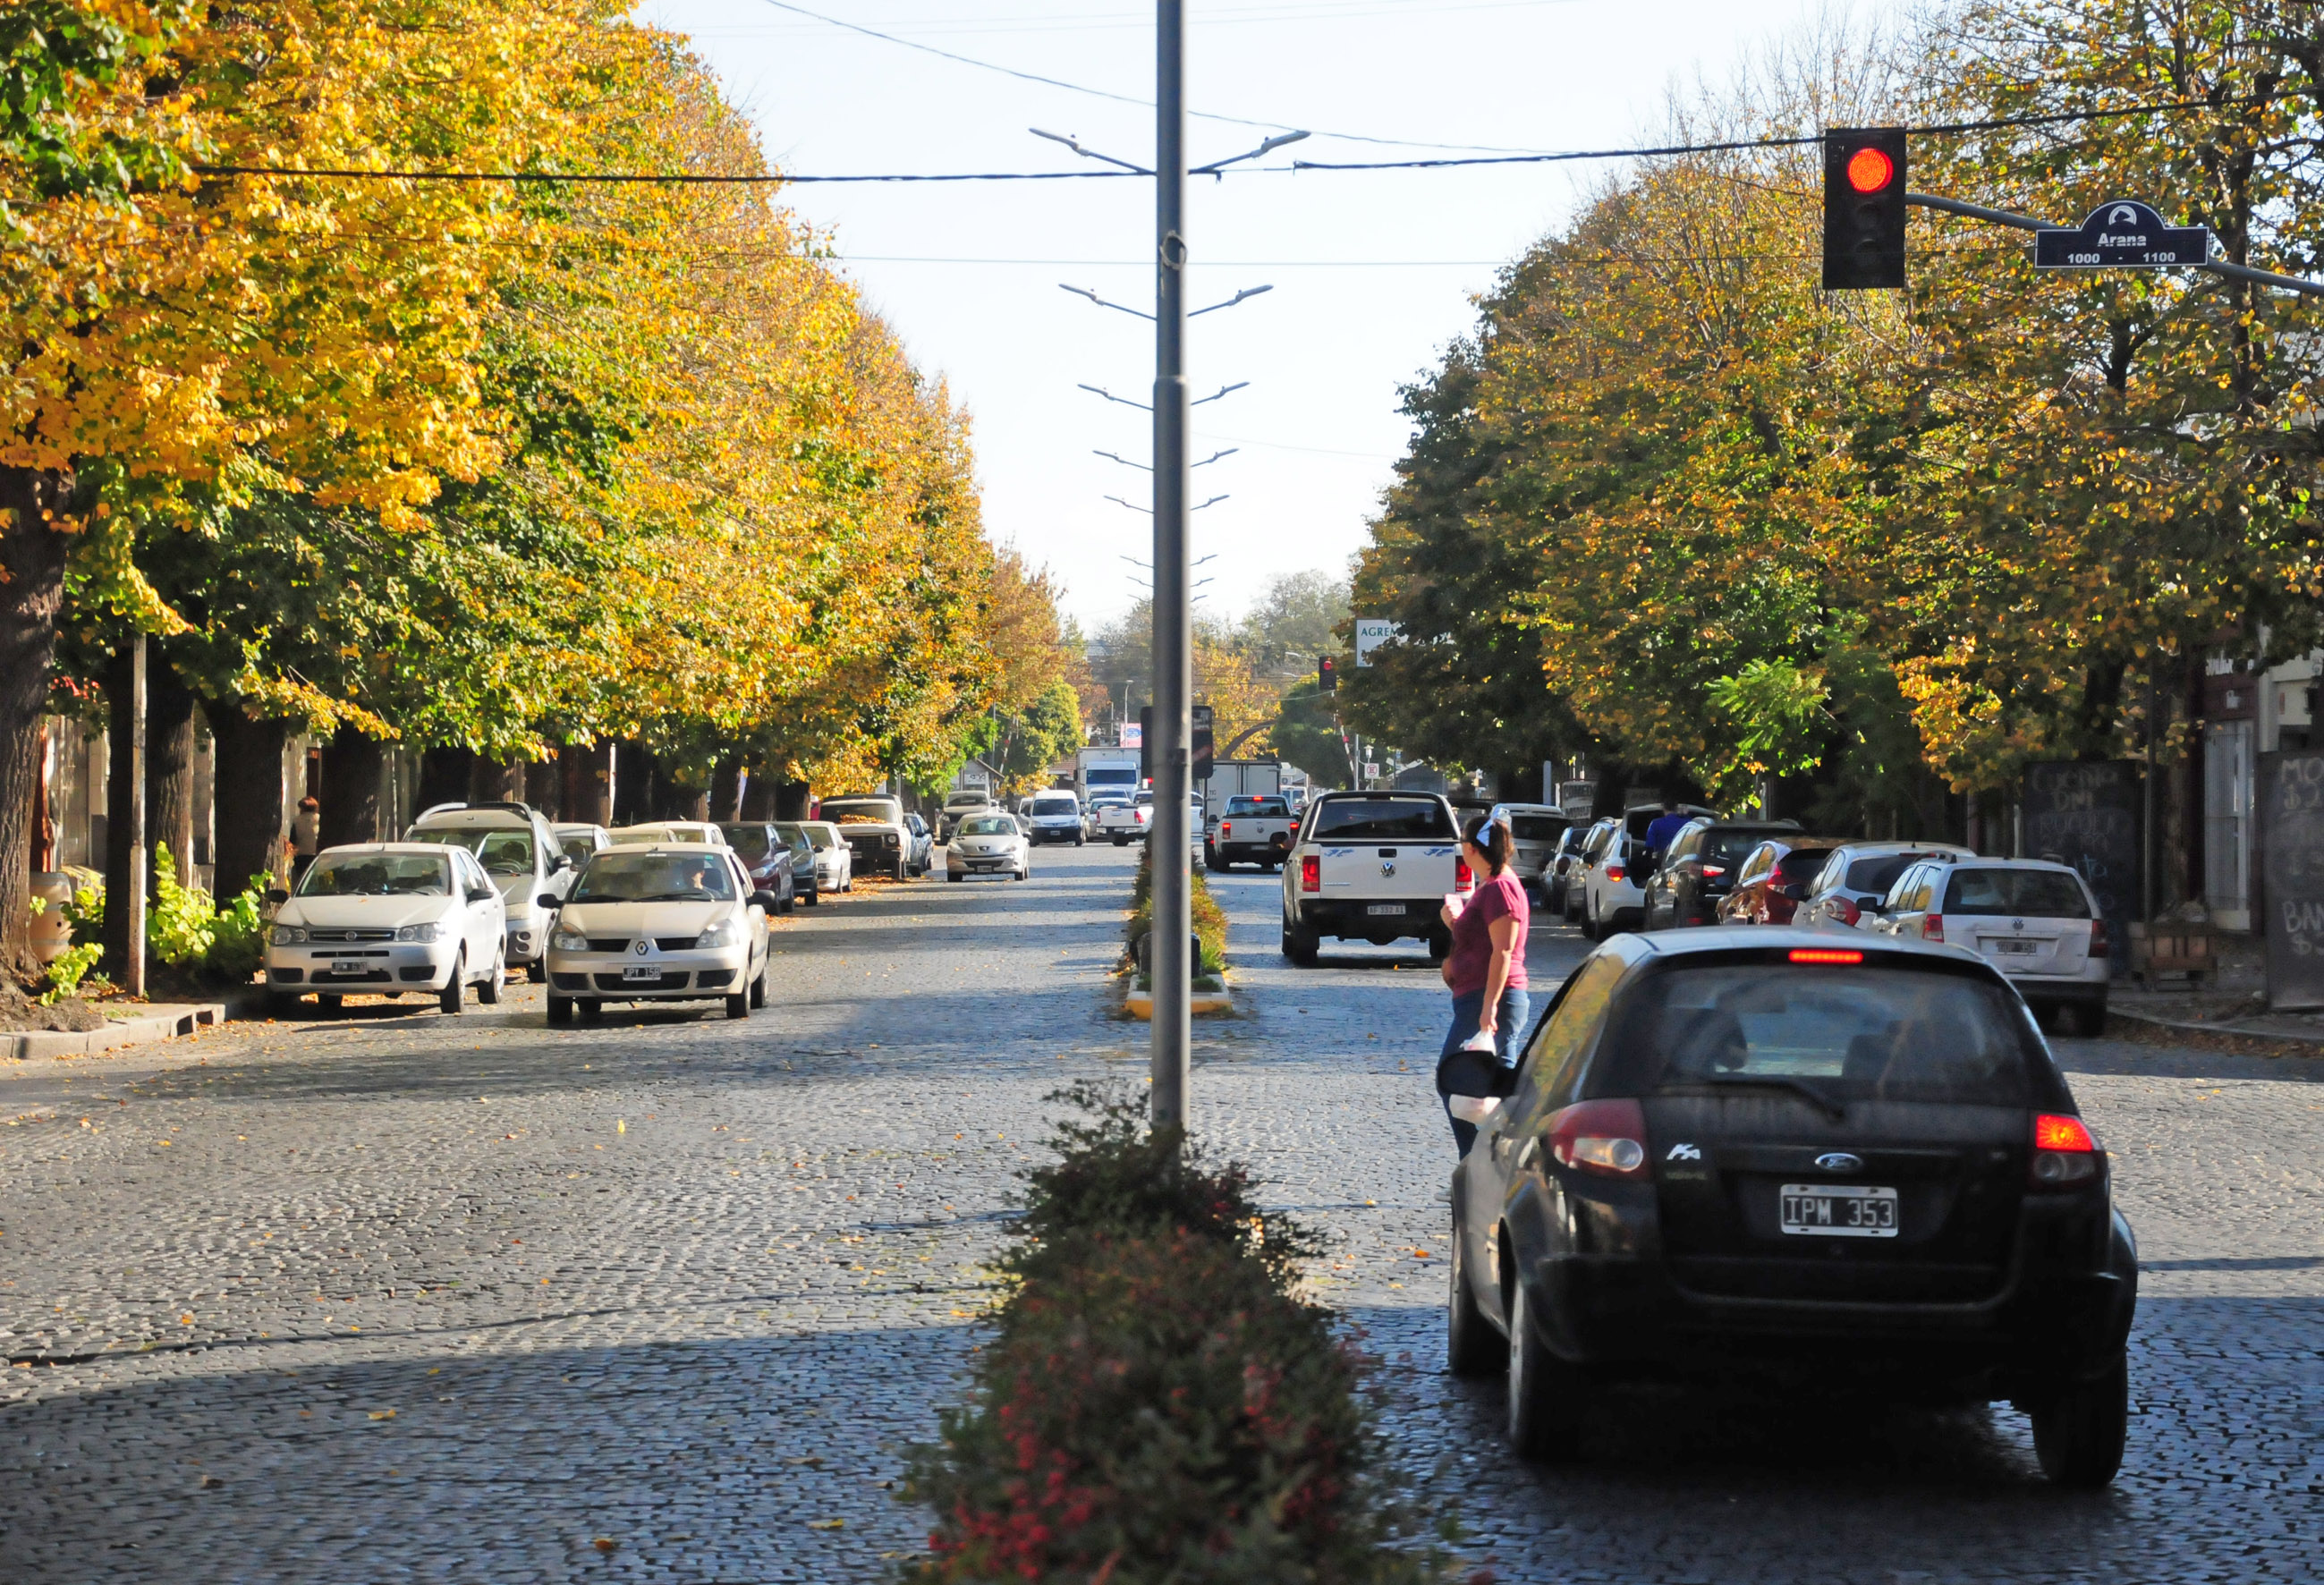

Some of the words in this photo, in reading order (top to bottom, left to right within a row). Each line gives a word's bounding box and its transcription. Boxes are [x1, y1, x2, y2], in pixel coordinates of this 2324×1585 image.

[2098, 233, 2147, 246] Arana
[2067, 253, 2100, 264] 1000
[2142, 252, 2176, 262] 1100
[1785, 1197, 1833, 1225] IPM
[1847, 1199, 1894, 1226] 353
